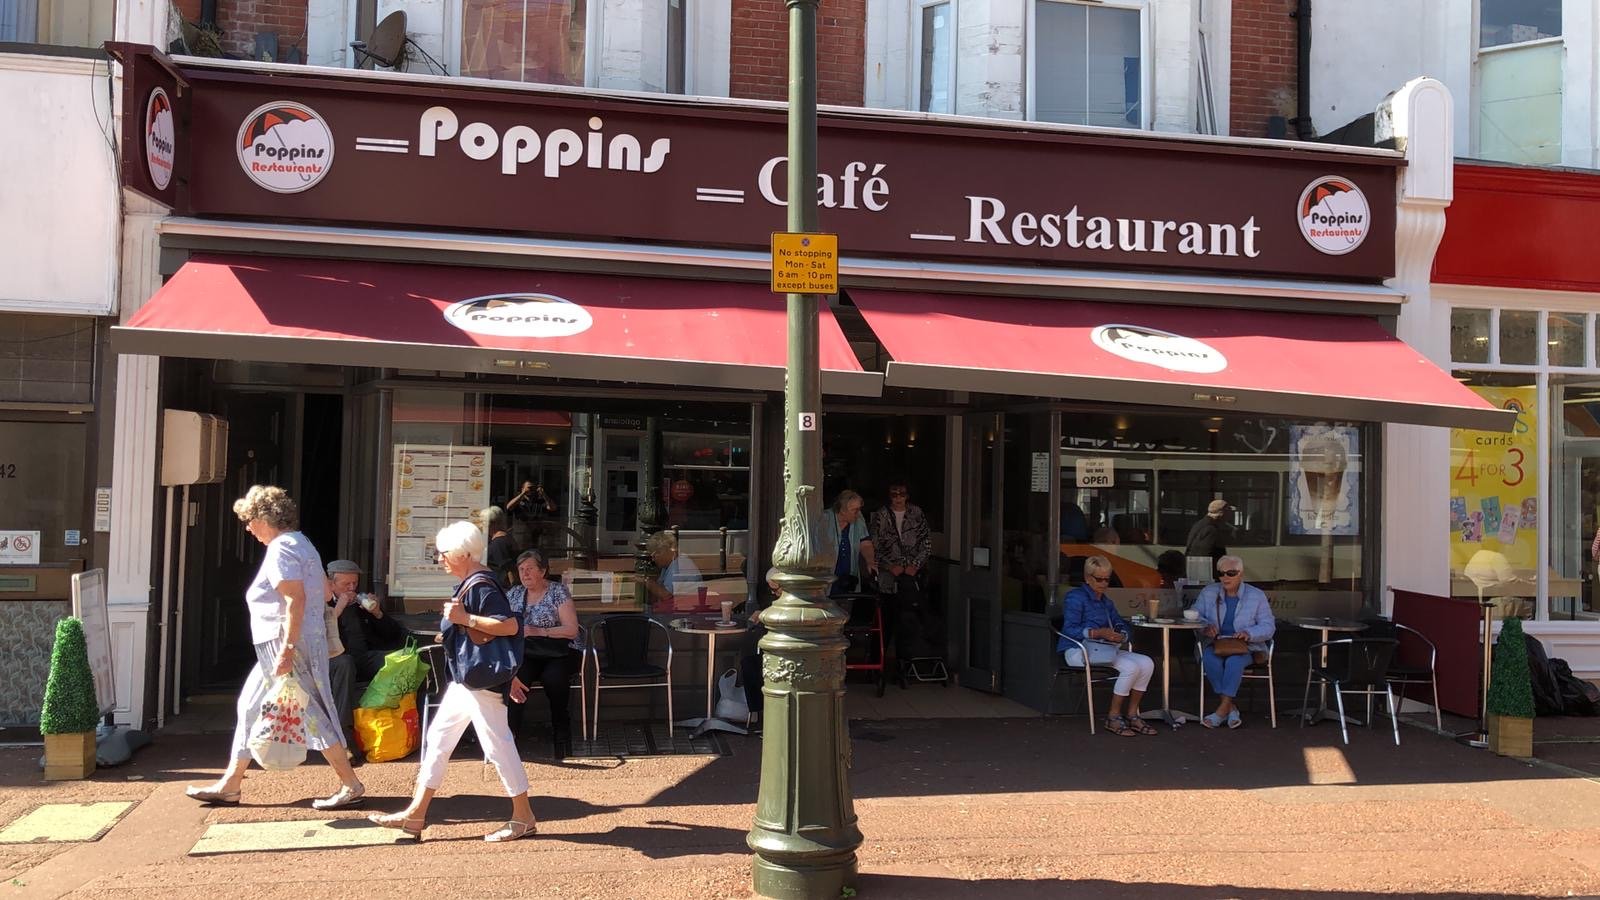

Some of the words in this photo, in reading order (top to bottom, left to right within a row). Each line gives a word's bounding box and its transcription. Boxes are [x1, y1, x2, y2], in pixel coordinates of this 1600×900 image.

[152, 131, 172, 154] Poppins
[418, 105, 671, 179] Poppins
[254, 142, 324, 160] Poppins
[252, 161, 322, 173] Restaurants
[757, 155, 891, 212] Café
[1311, 212, 1363, 226] Poppins
[963, 194, 1262, 258] Restaurant
[1310, 228, 1362, 238] Restaurants
[794, 250, 832, 258] stopping
[785, 260, 804, 268] Mon
[811, 261, 826, 269] Sat
[778, 270, 784, 278] 6
[808, 271, 817, 279] 10
[471, 314, 578, 324] Poppins
[803, 415, 812, 428] 8
[1475, 434, 1514, 446] cards
[1455, 448, 1478, 487] 4
[1480, 464, 1506, 475] FOR
[1502, 448, 1525, 486] 3
[1082, 476, 1108, 485] OPEN
